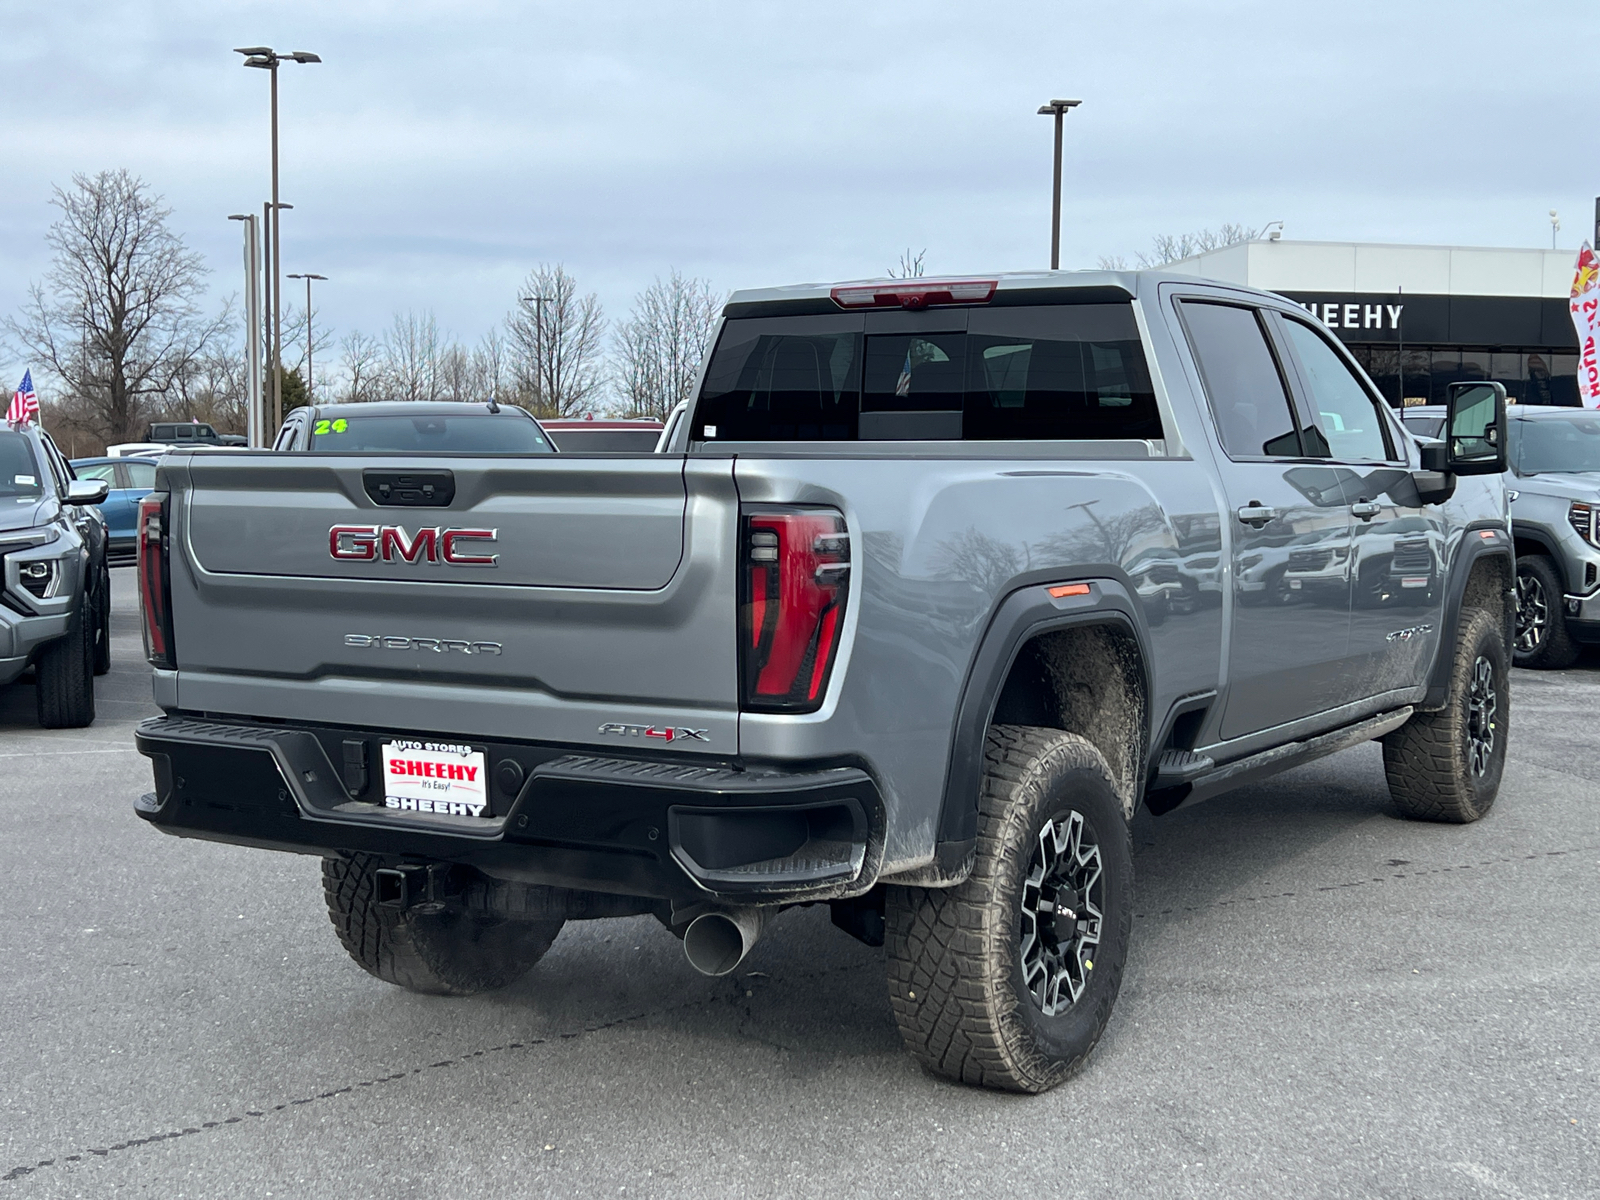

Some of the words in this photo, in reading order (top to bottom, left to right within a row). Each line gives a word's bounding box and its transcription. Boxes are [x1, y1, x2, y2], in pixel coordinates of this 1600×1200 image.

[1299, 302, 1404, 329] EEHY
[314, 418, 348, 435] 24
[328, 523, 499, 567] GMC
[344, 633, 502, 656] SIERRA
[598, 722, 711, 744] AT4X
[390, 739, 422, 751] AUTO
[424, 742, 472, 755] STORES
[389, 758, 478, 782] SHEEHY
[421, 779, 432, 789] It's
[433, 780, 451, 792] Easy!
[385, 796, 485, 817] SHEEHY
